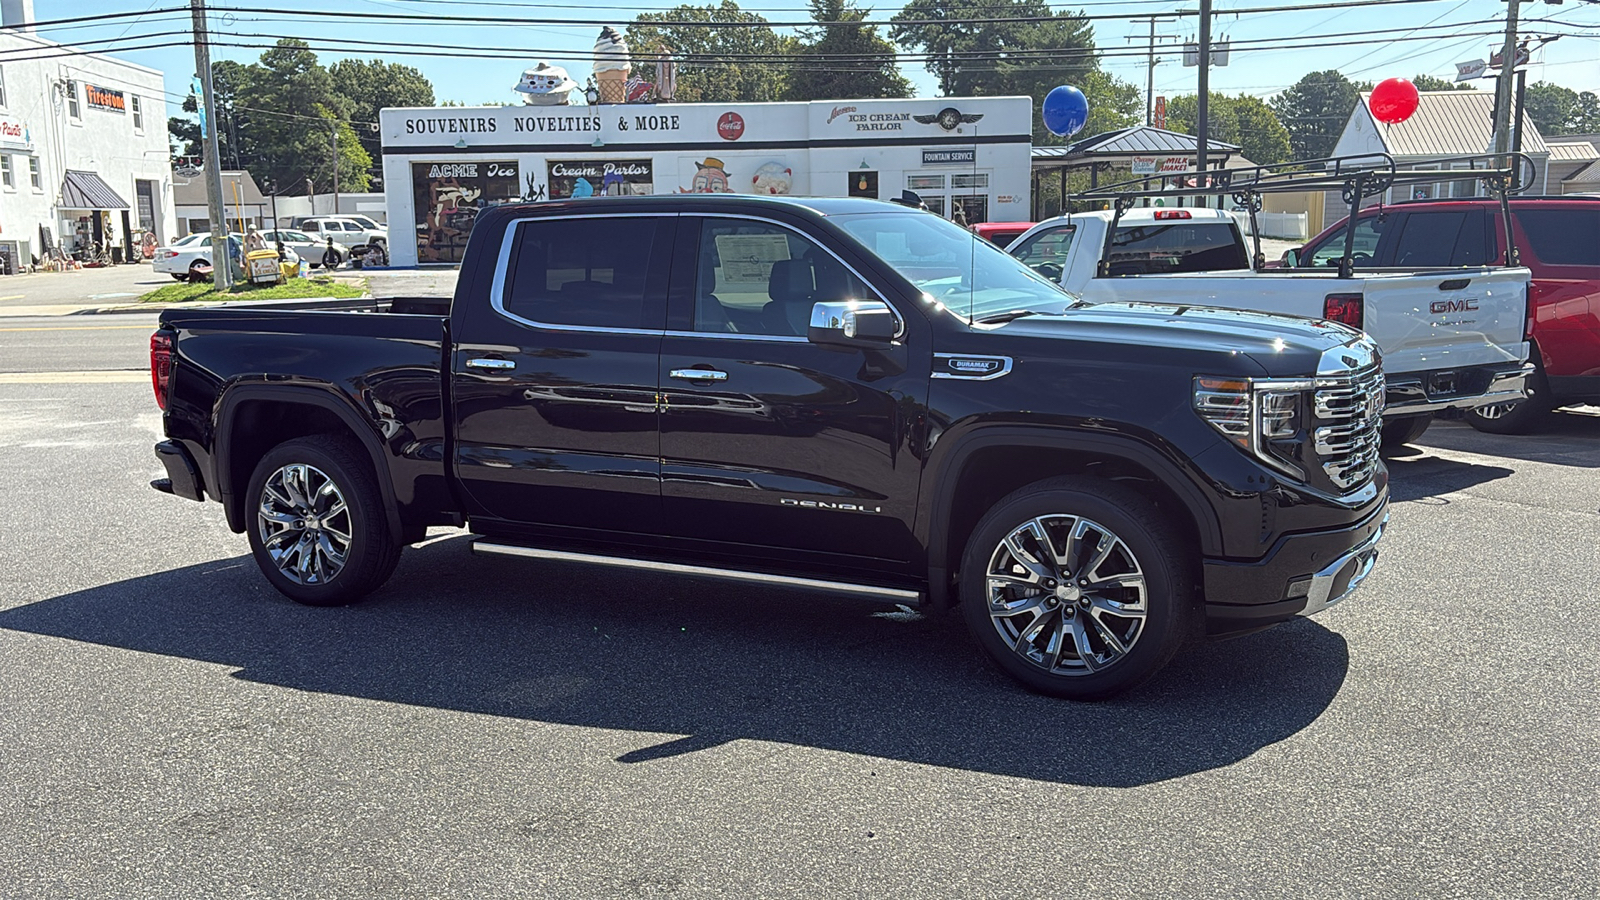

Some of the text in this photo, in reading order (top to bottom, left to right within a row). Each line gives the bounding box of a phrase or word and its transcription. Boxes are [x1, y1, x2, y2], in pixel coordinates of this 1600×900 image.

[86, 84, 125, 109] Firestone
[406, 115, 680, 134] SOUVENIRS NOVELTIES & MORE
[848, 114, 867, 122] ICE
[869, 113, 911, 121] CREAM
[2, 121, 21, 137] Paints
[856, 122, 902, 131] PARLOR
[924, 152, 973, 161] FOUNTAIN SERVICE
[428, 163, 516, 178] ACME Ice
[551, 162, 650, 177] Cream Parlor
[1160, 164, 1188, 172] SHAKES
[1429, 298, 1479, 314] GMC
[956, 361, 990, 369] DURAMAX
[780, 498, 881, 513] DENALI
